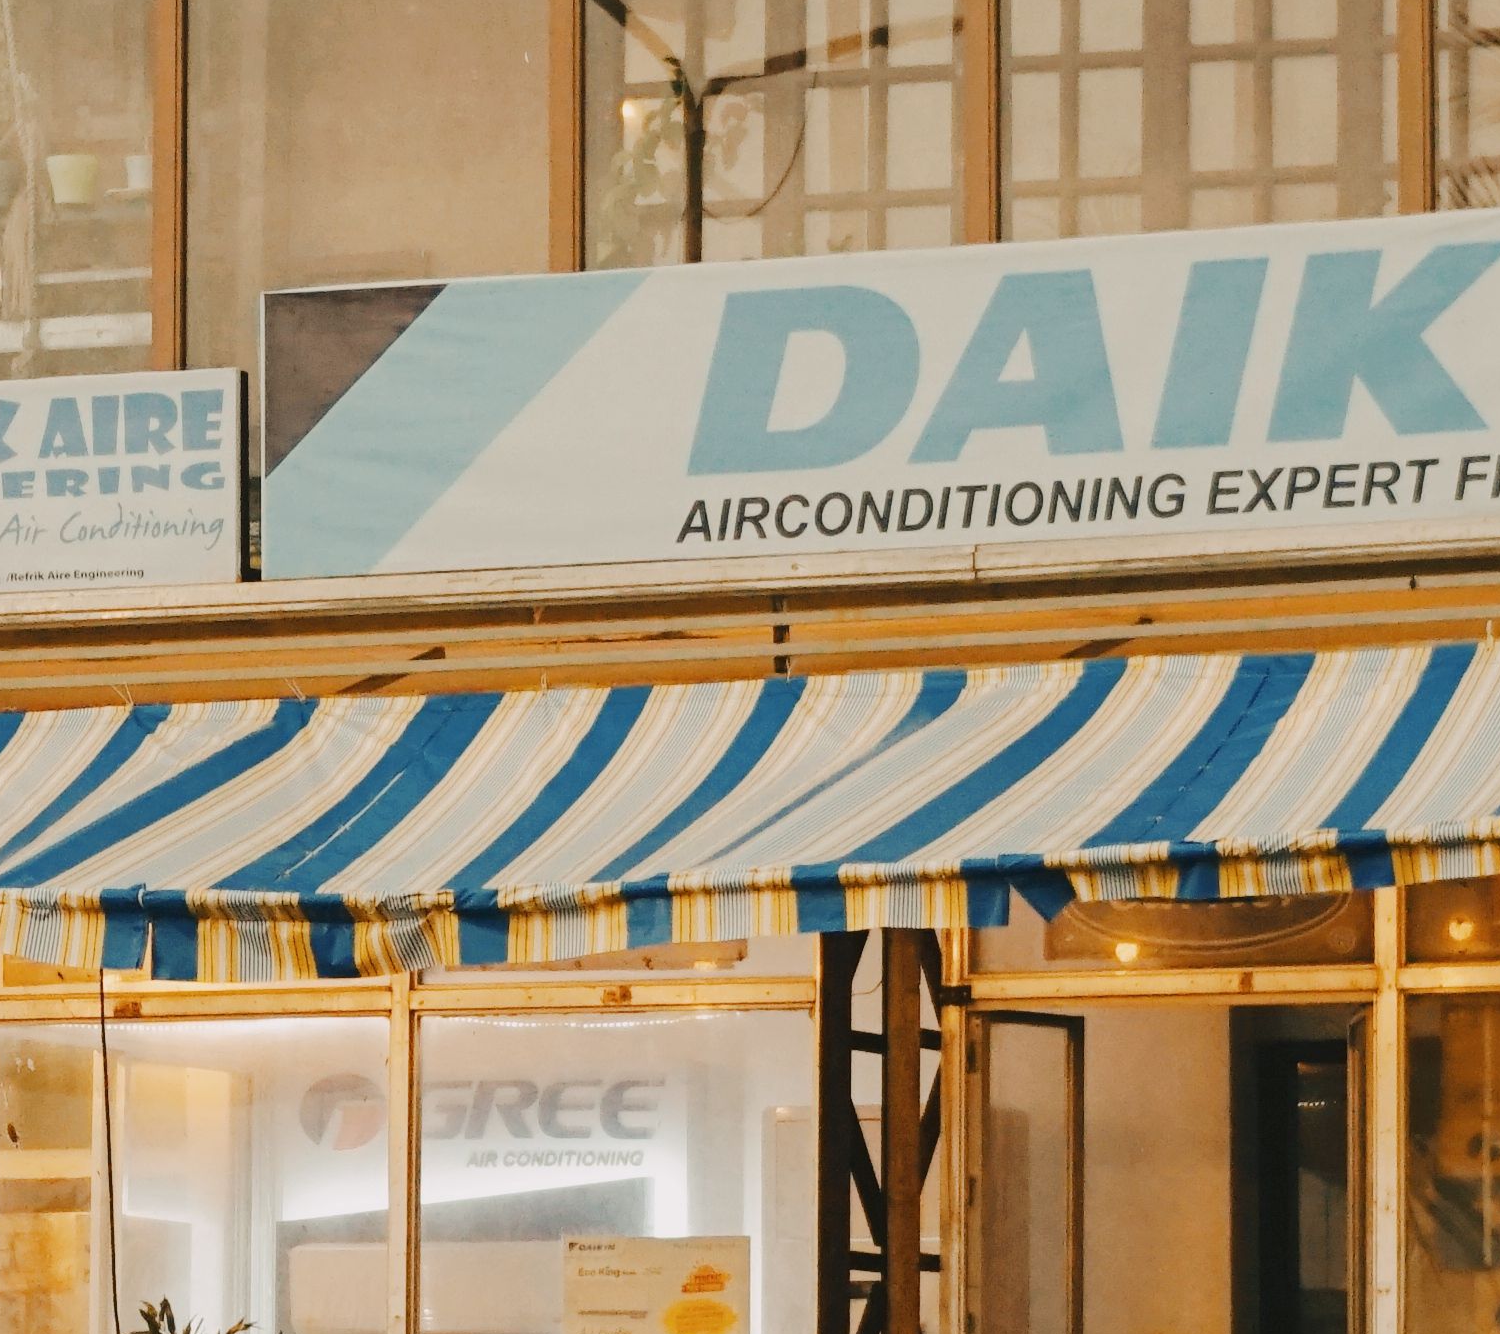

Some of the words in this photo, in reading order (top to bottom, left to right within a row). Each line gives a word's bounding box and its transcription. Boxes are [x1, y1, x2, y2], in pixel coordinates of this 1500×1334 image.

[38, 389, 224, 458] AIRE
[59, 503, 225, 550] Conditioning
[676, 473, 1186, 543] AIRCONDITIONING
[1206, 457, 1439, 517] EXPERT
[47, 571, 71, 581] Aire
[73, 568, 145, 581] Engineering
[421, 1078, 666, 1140] GREE
[466, 1151, 498, 1168] AIR
[502, 1149, 645, 1168] CONDITIONING
